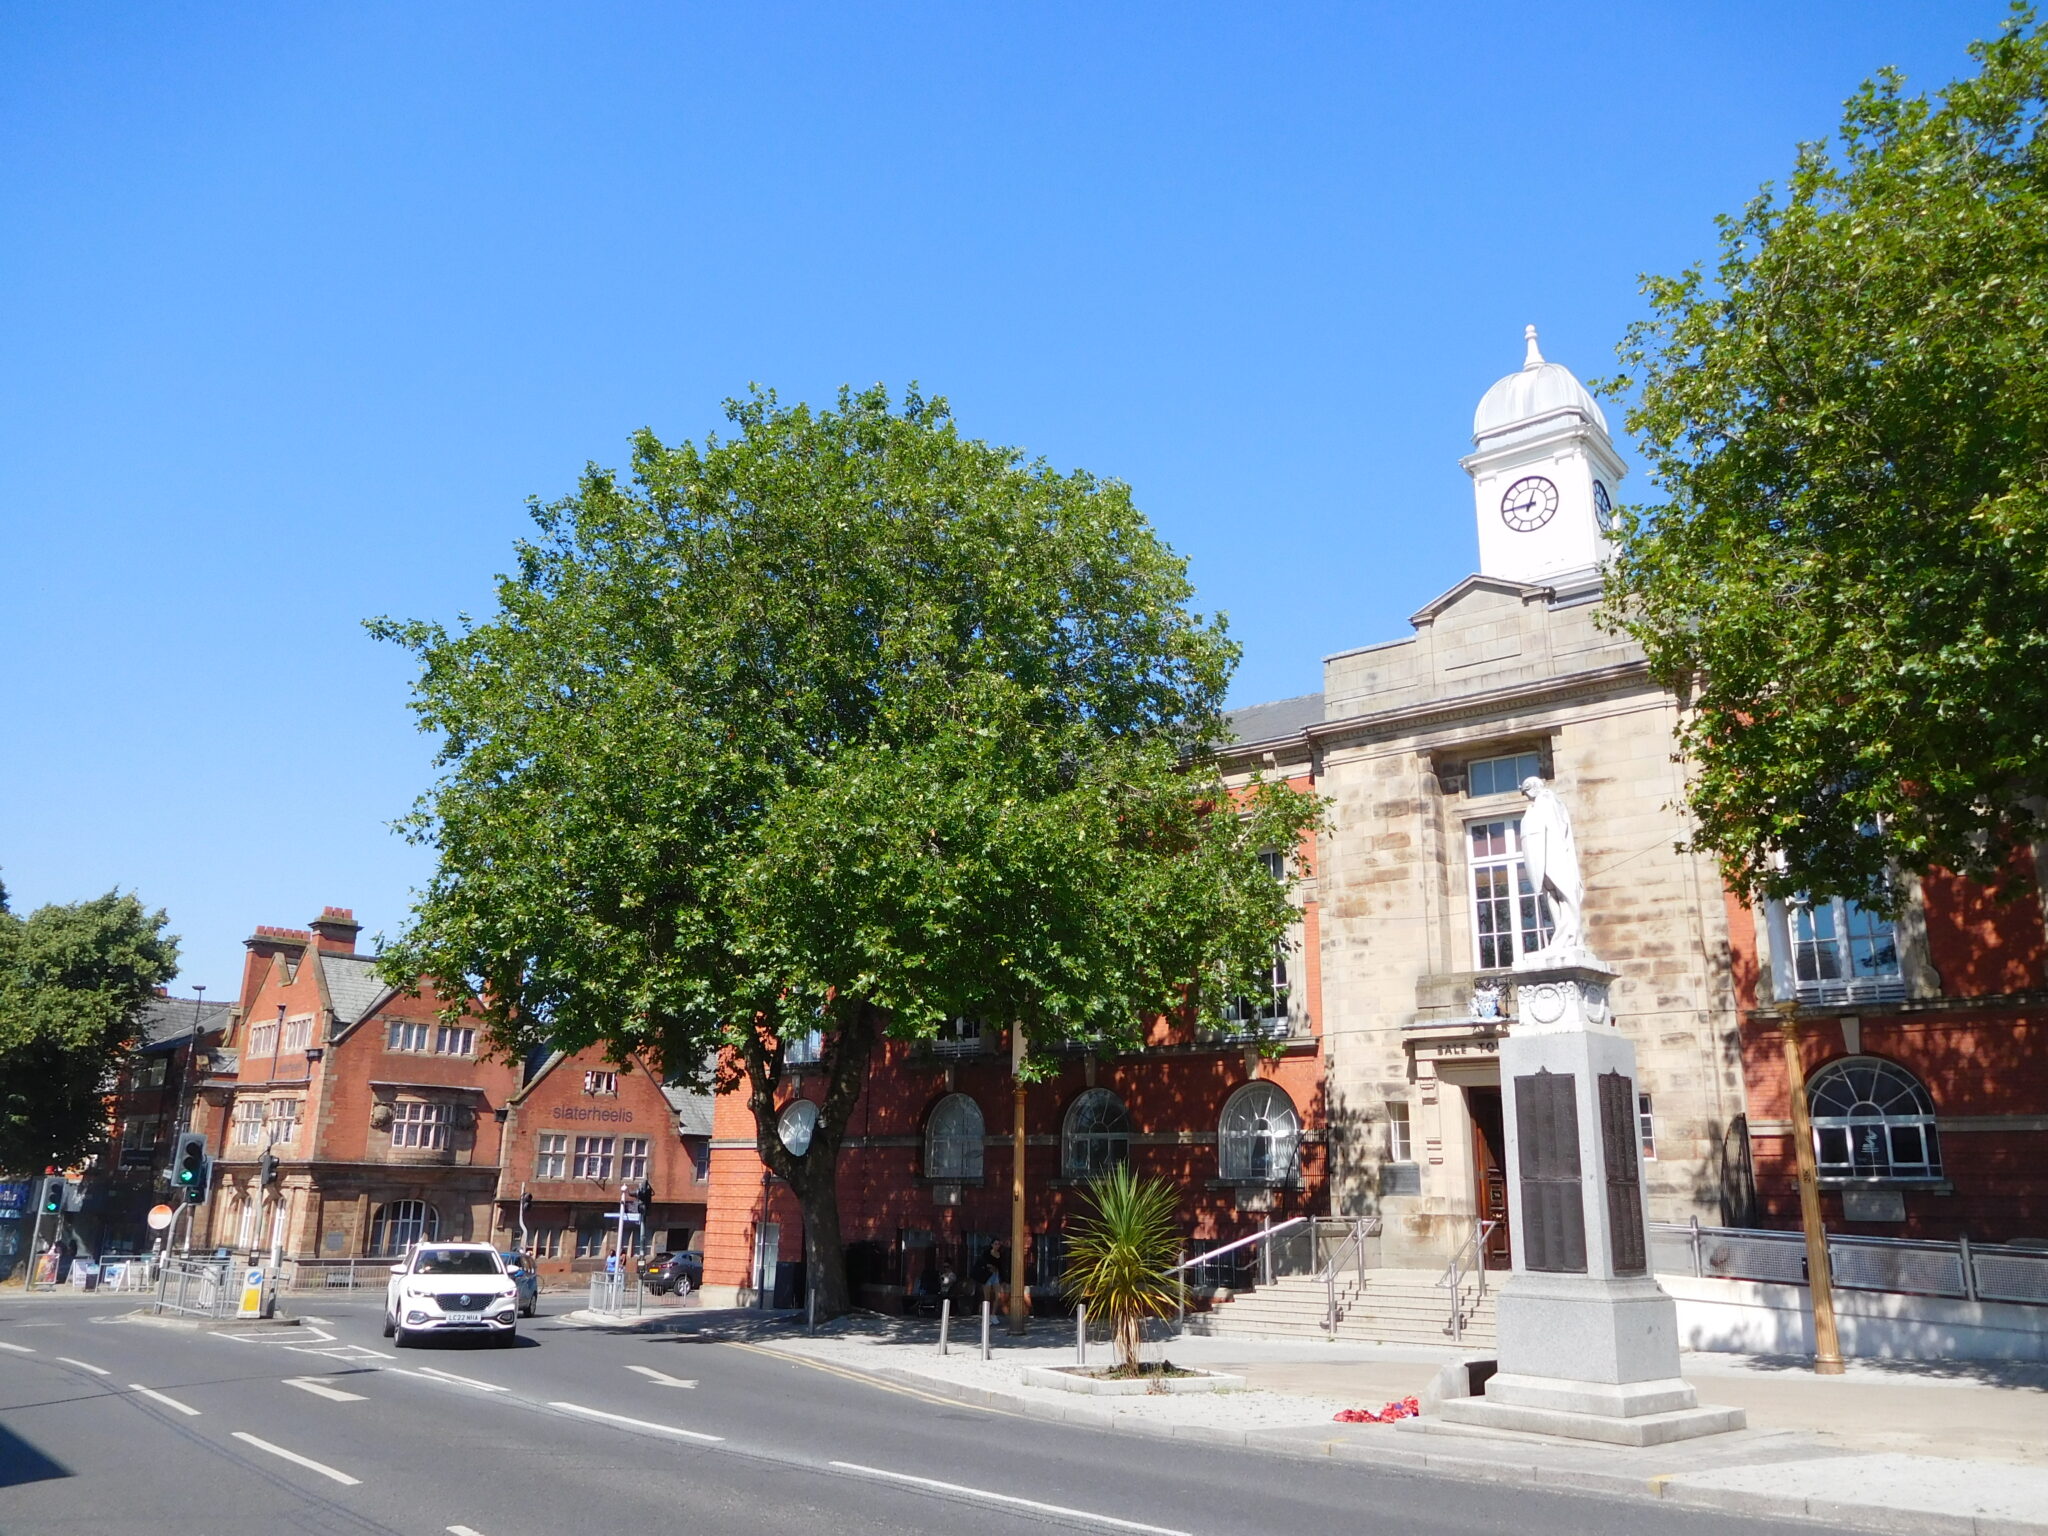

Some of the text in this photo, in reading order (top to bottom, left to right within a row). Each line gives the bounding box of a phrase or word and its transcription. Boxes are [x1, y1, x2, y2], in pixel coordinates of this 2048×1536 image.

[1437, 1041, 1499, 1056] SALE TO
[553, 1103, 633, 1123] slaterheelis
